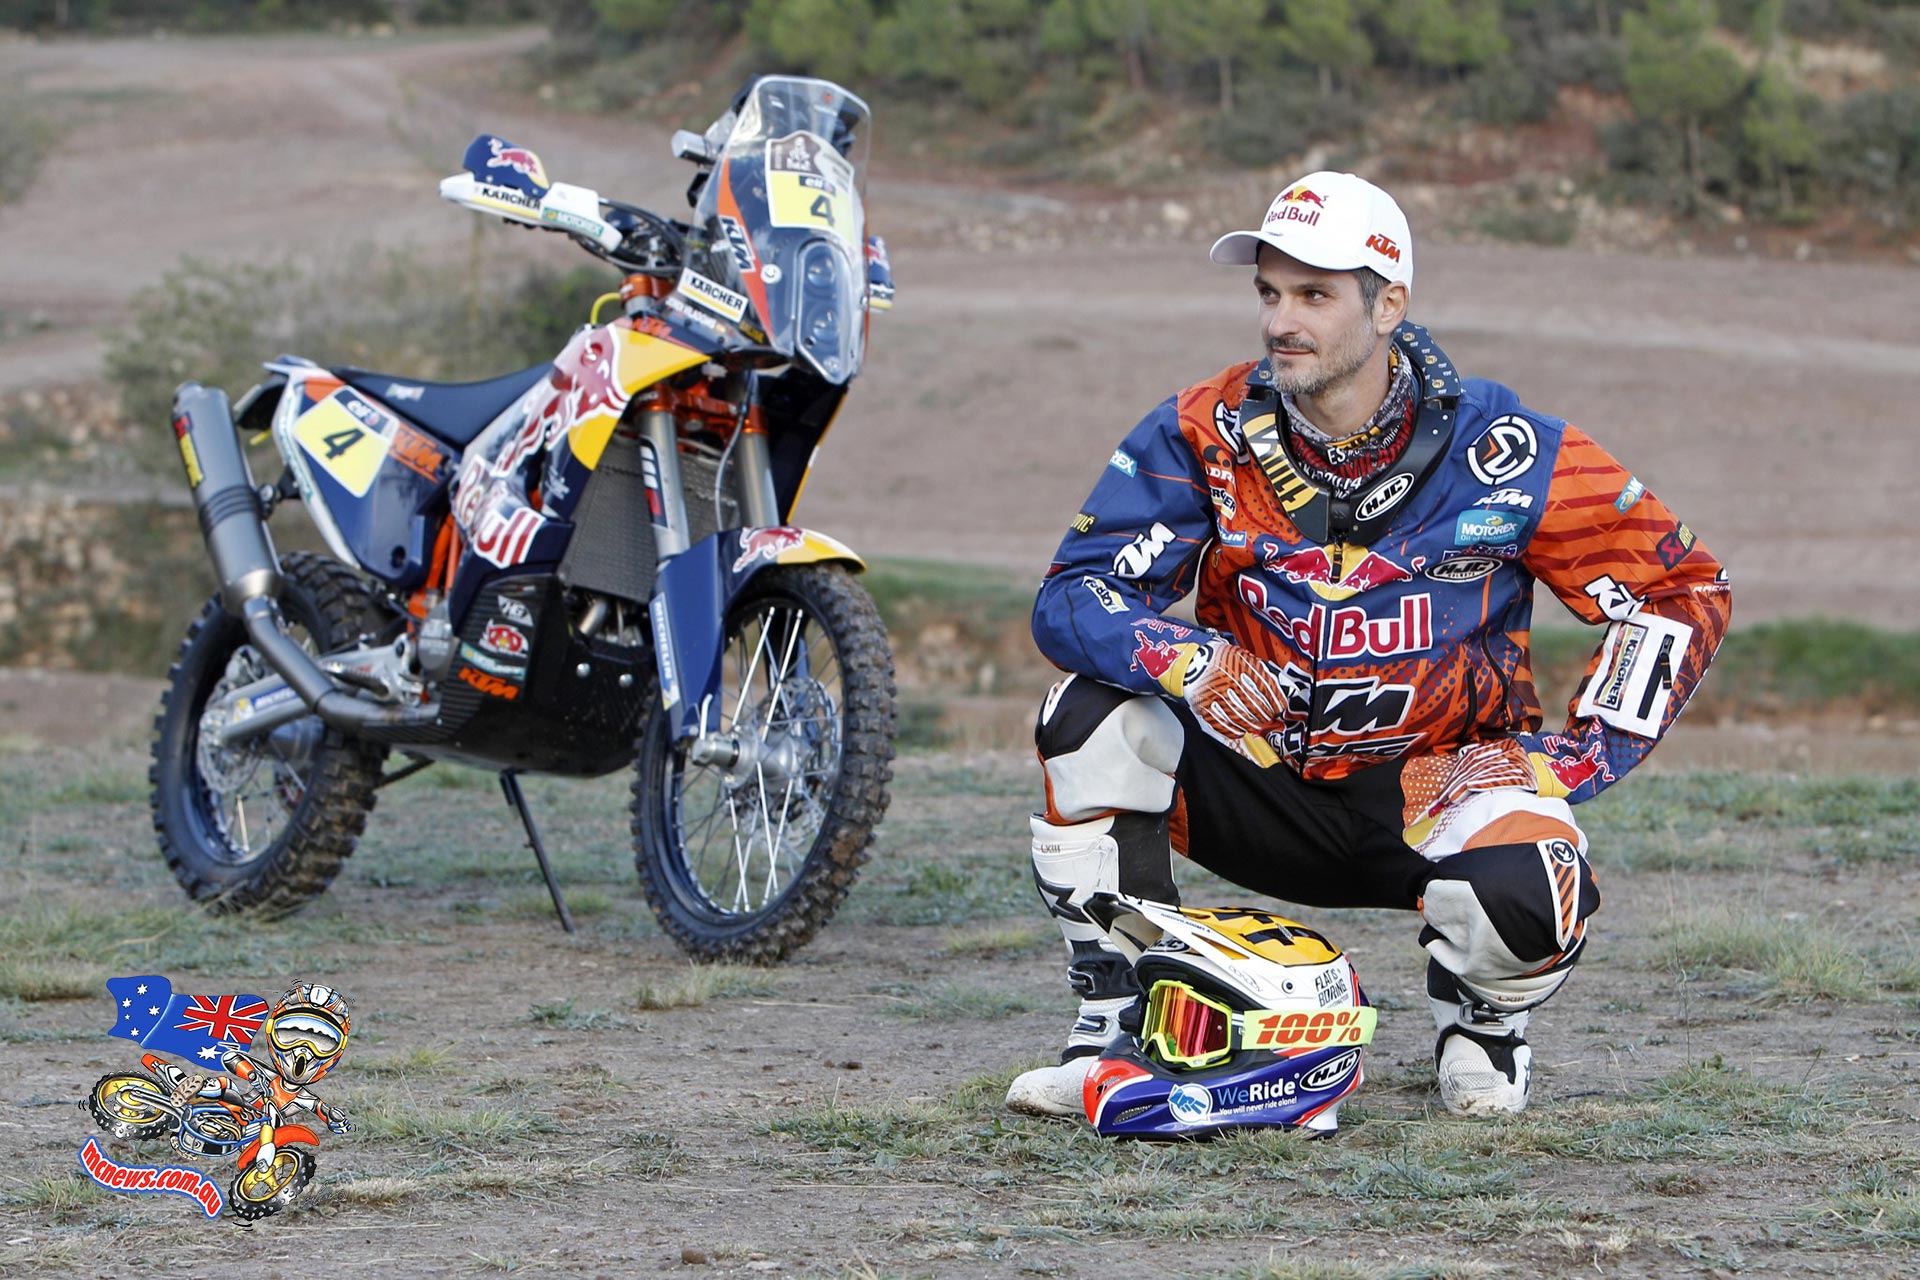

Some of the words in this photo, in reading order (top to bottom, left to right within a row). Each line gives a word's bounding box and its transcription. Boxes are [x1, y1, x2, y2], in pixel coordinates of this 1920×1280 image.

[811, 195, 835, 226] 4
[1266, 206, 1286, 225] Red
[1287, 206, 1320, 226] Bull
[1365, 233, 1400, 263] KTM
[322, 427, 365, 460] 4
[1365, 478, 1404, 515] HJC
[1473, 488, 1533, 509] KTM
[1461, 523, 1517, 537] MOTOREX
[1437, 560, 1489, 575] HJC
[1584, 575, 1646, 621] KT
[1239, 574, 1326, 660] Red
[1327, 593, 1432, 659] Bull
[654, 601, 673, 679] MICHELIN
[459, 667, 518, 699] KTM
[1315, 969, 1332, 992] FLAT
[1318, 978, 1347, 1007] BORING
[1256, 1011, 1361, 1045] 100%
[1314, 1050, 1360, 1086] HJC
[1219, 1107, 1233, 1116] You
[1233, 1105, 1246, 1114] will
[1246, 1103, 1264, 1112] never
[1264, 1100, 1277, 1110] ride
